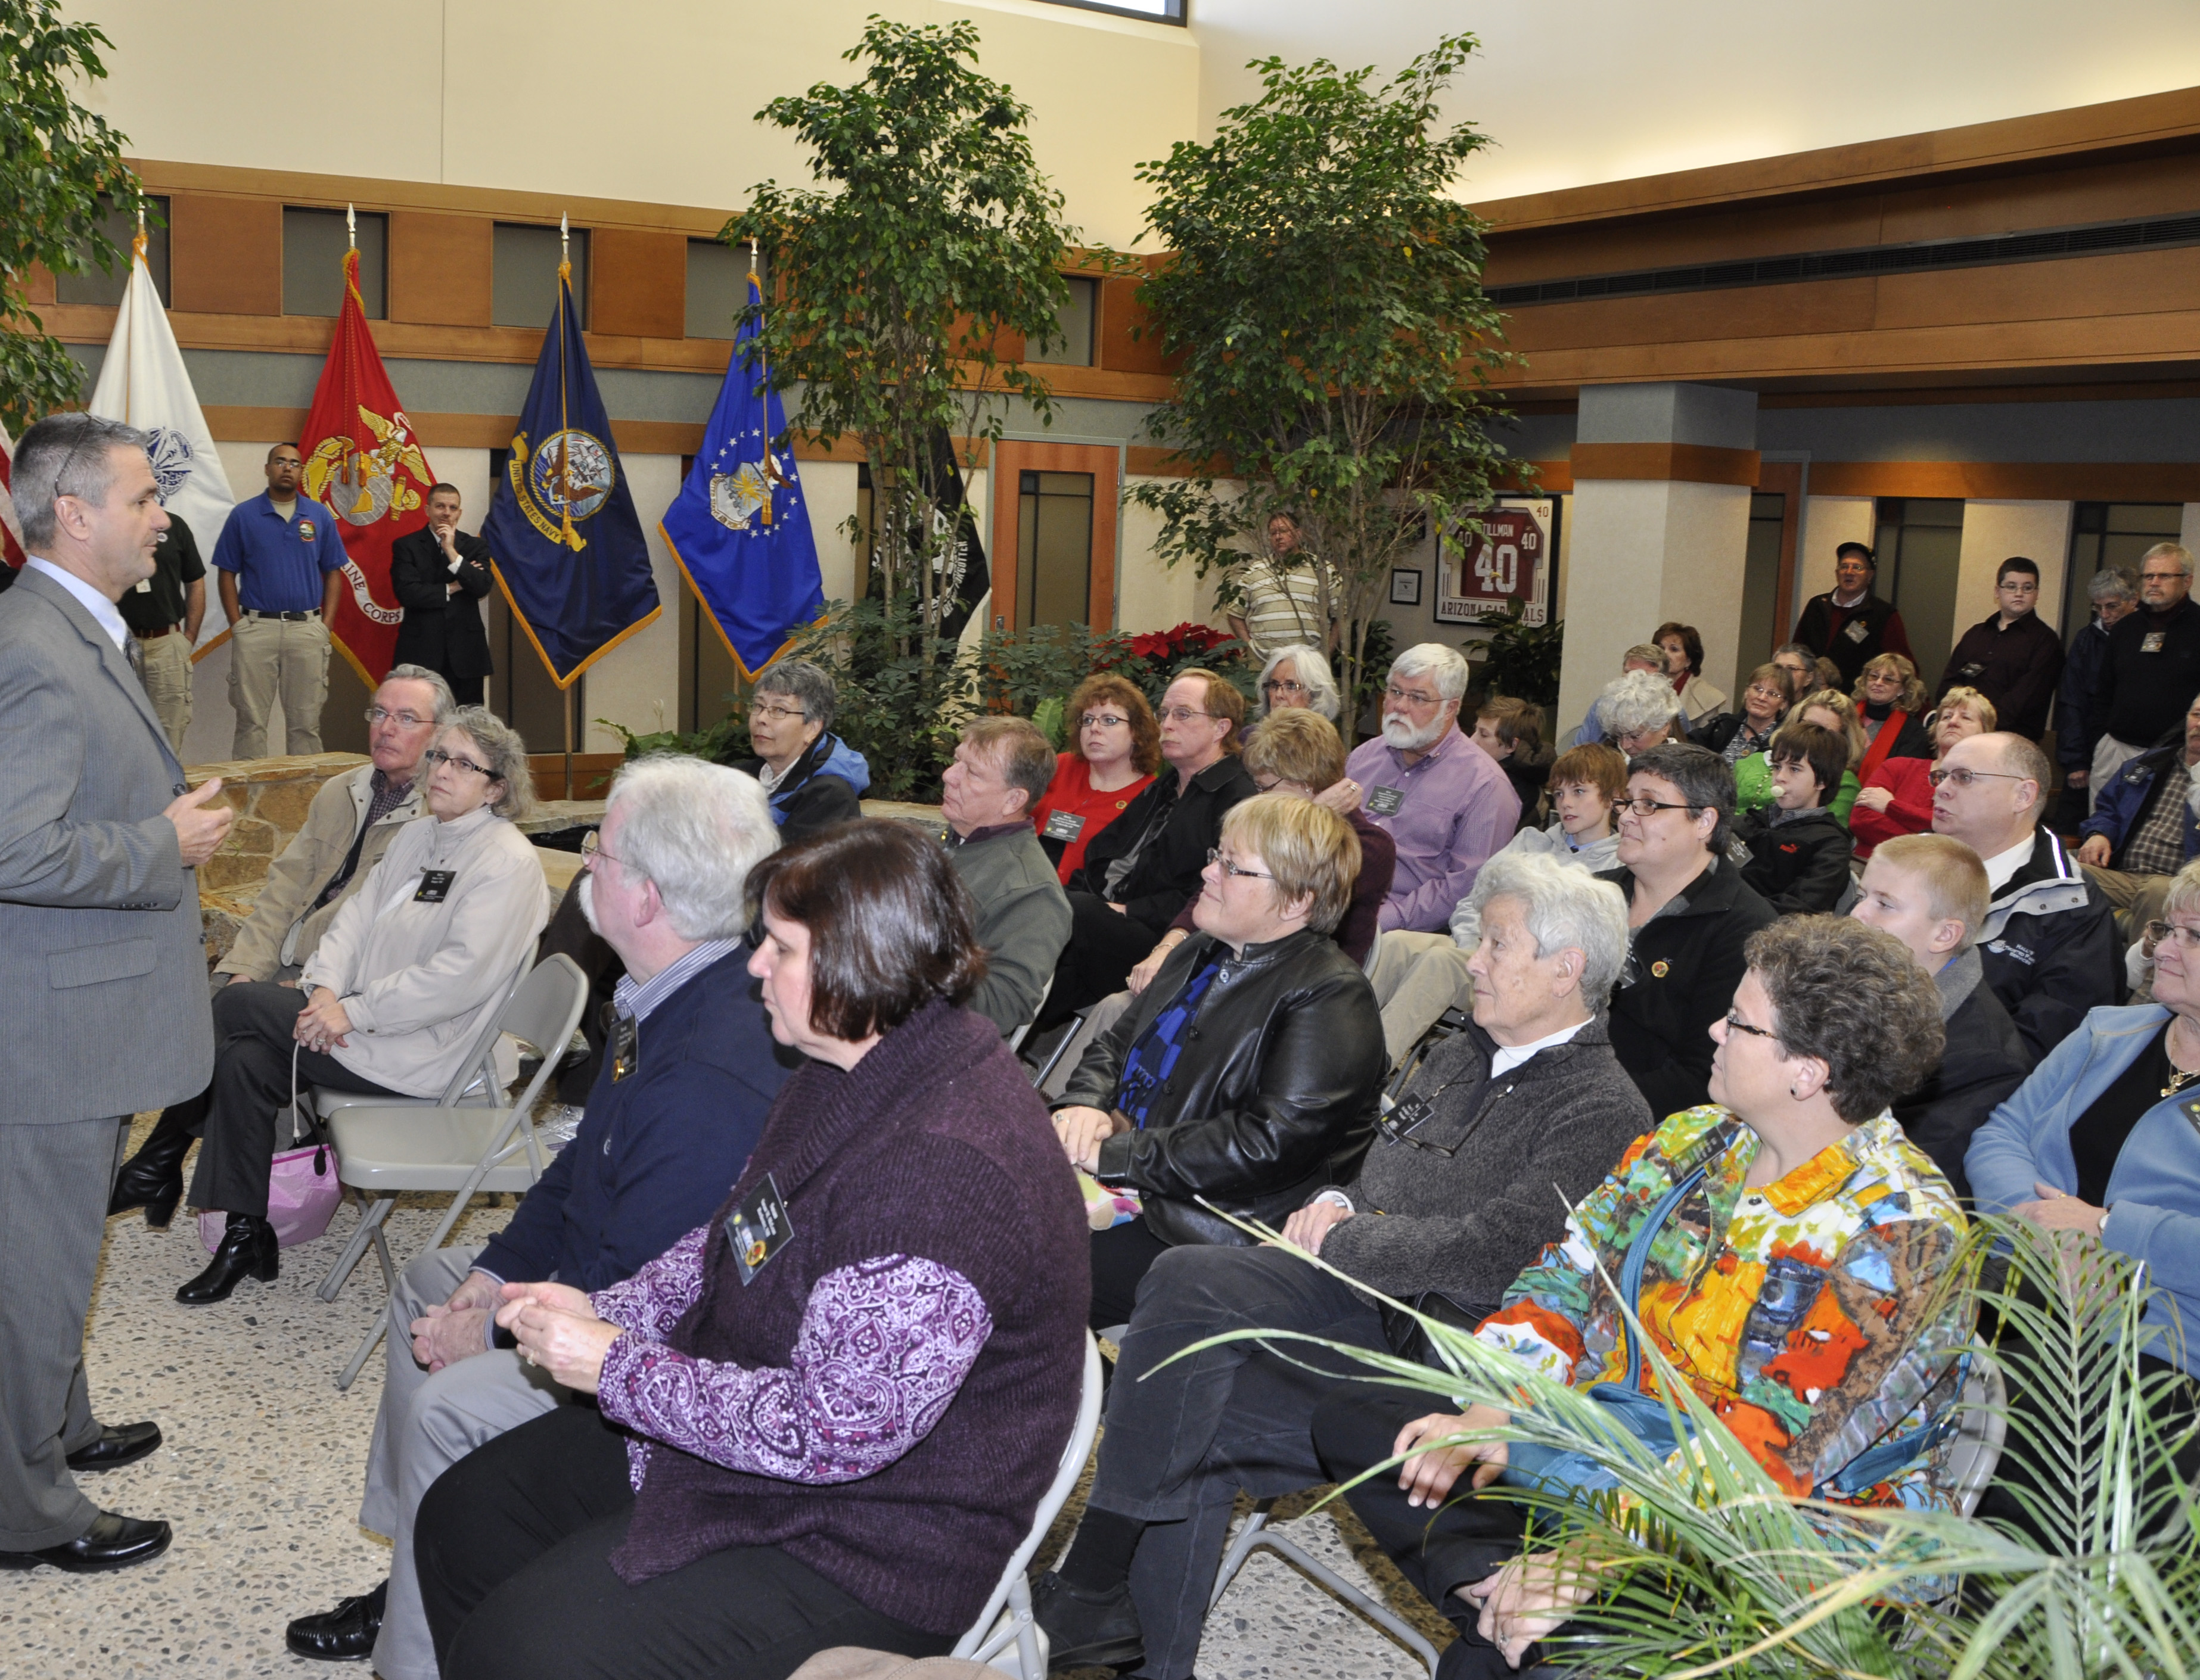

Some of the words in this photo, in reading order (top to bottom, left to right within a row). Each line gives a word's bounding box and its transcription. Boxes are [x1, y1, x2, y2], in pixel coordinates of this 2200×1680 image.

[519, 496, 542, 524] STATES
[539, 521, 560, 539] NAVY
[1536, 506, 1549, 517] 40
[1483, 523, 1514, 537] TILLMAN
[1521, 533, 1537, 550] 40
[1474, 543, 1518, 593] 40
[343, 564, 366, 590] INE
[363, 602, 400, 623] CORPS
[1441, 601, 1481, 617] ARIZONA
